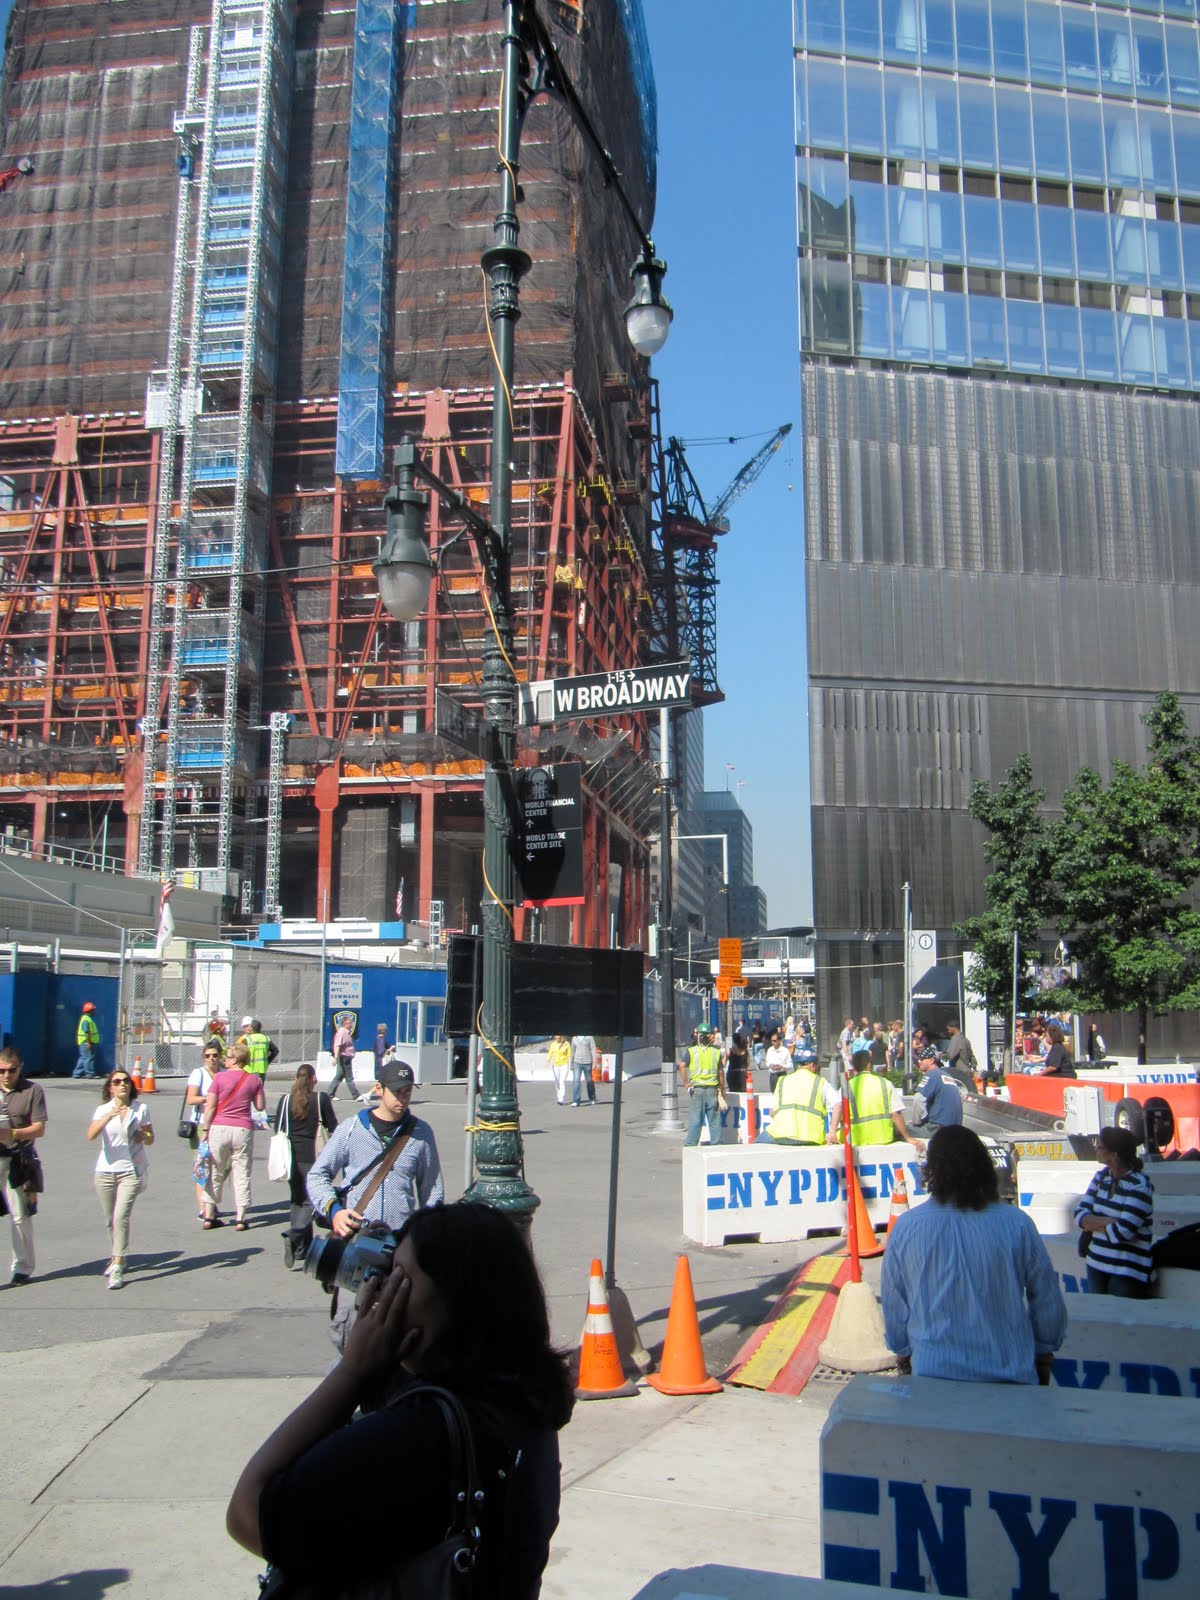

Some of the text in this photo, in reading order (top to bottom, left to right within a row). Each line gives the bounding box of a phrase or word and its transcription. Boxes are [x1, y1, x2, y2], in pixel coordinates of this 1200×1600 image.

[607, 671, 626, 684] 1-15
[557, 673, 690, 712] W BROADWAY
[525, 798, 575, 809] WORLD FINANCIAL
[525, 809, 548, 817] CENTER
[547, 832, 566, 840] TRADE
[526, 842, 548, 850] CENTER
[728, 1167, 840, 1208] NYPD
[888, 1480, 1200, 1600] NYP
